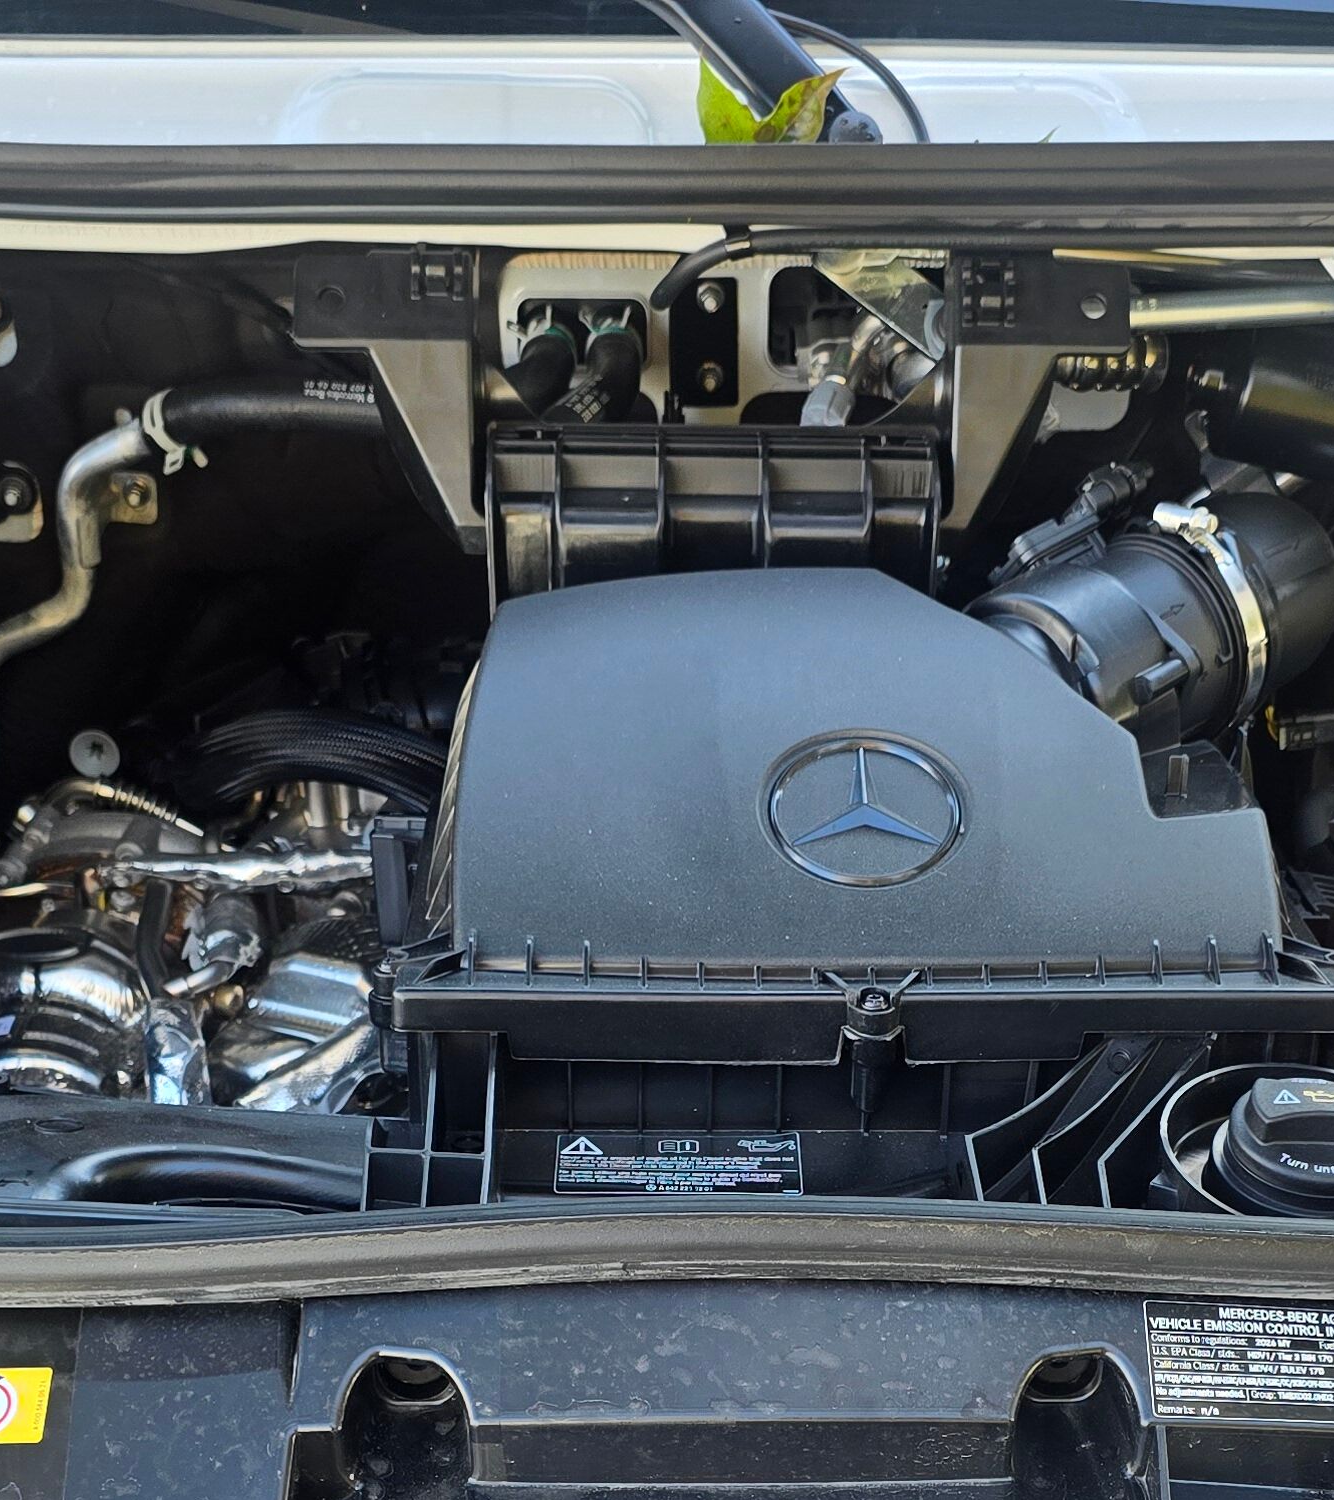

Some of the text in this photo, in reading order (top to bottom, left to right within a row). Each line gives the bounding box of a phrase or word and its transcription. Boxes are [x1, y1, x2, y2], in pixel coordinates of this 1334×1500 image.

[1279, 1152, 1310, 1171] Turn
[1218, 1307, 1319, 1324] MERCEDES-BENZ
[1149, 1316, 1202, 1331] VEHICLE
[1203, 1319, 1263, 1334] EMISSION
[1266, 1323, 1324, 1337] CONTROL
[1150, 1333, 1191, 1343] Conforms
[1191, 1335, 1201, 1343] to
[1201, 1335, 1248, 1346] regulations:
[1152, 1347, 1170, 1356] U.S.
[1171, 1348, 1188, 1357] EPA
[1153, 1360, 1192, 1370] California
[1157, 1404, 1220, 1416] Remarks: n/a
